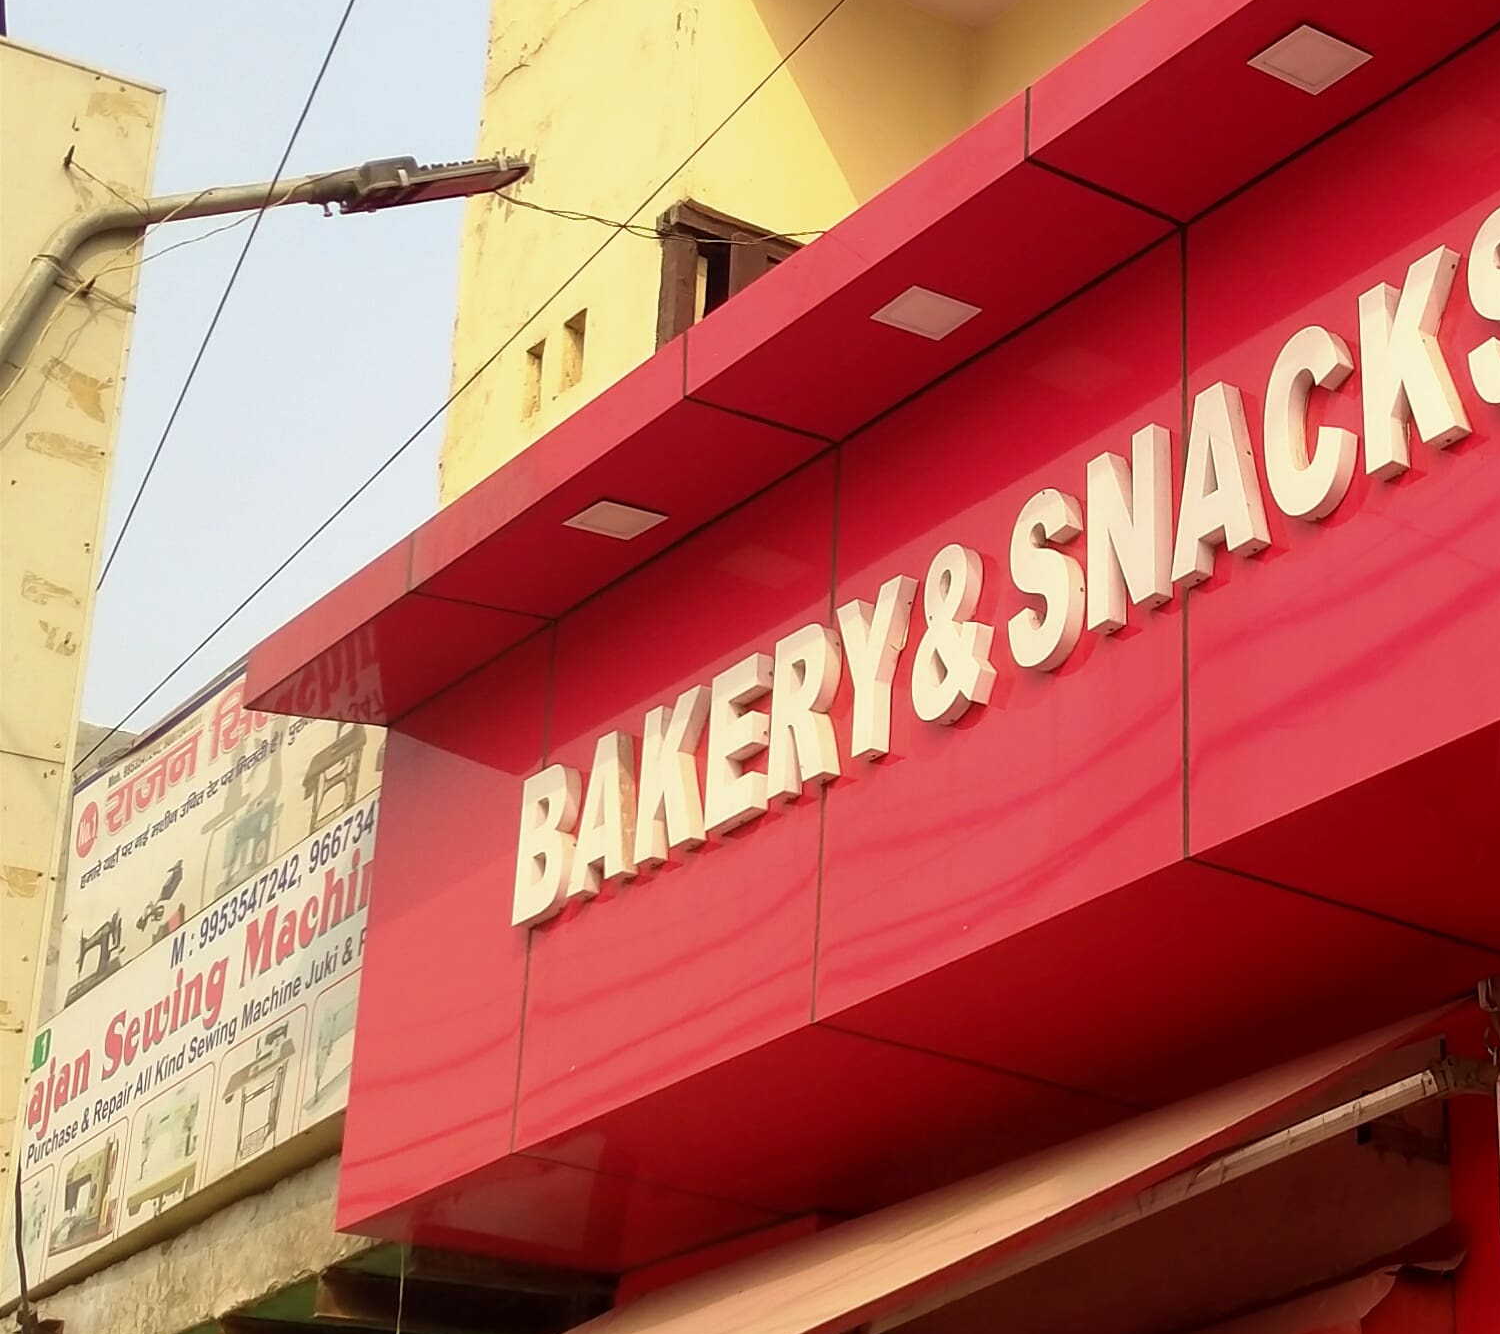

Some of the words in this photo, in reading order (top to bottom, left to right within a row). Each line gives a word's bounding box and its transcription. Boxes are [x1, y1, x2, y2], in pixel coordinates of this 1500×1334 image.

[308, 795, 379, 874] 966734
[511, 573, 919, 927] BAKERY
[24, 1048, 91, 1141] ajan
[101, 955, 230, 1082] Sewing
[26, 1119, 79, 1170] Purchase
[81, 1107, 90, 1133] &
[93, 1080, 133, 1127] Repair
[134, 1065, 152, 1100] All
[154, 1044, 187, 1086] Kind
[187, 1016, 239, 1065] Sewing
[241, 975, 302, 1030] Machine
[305, 946, 338, 990] Juki
